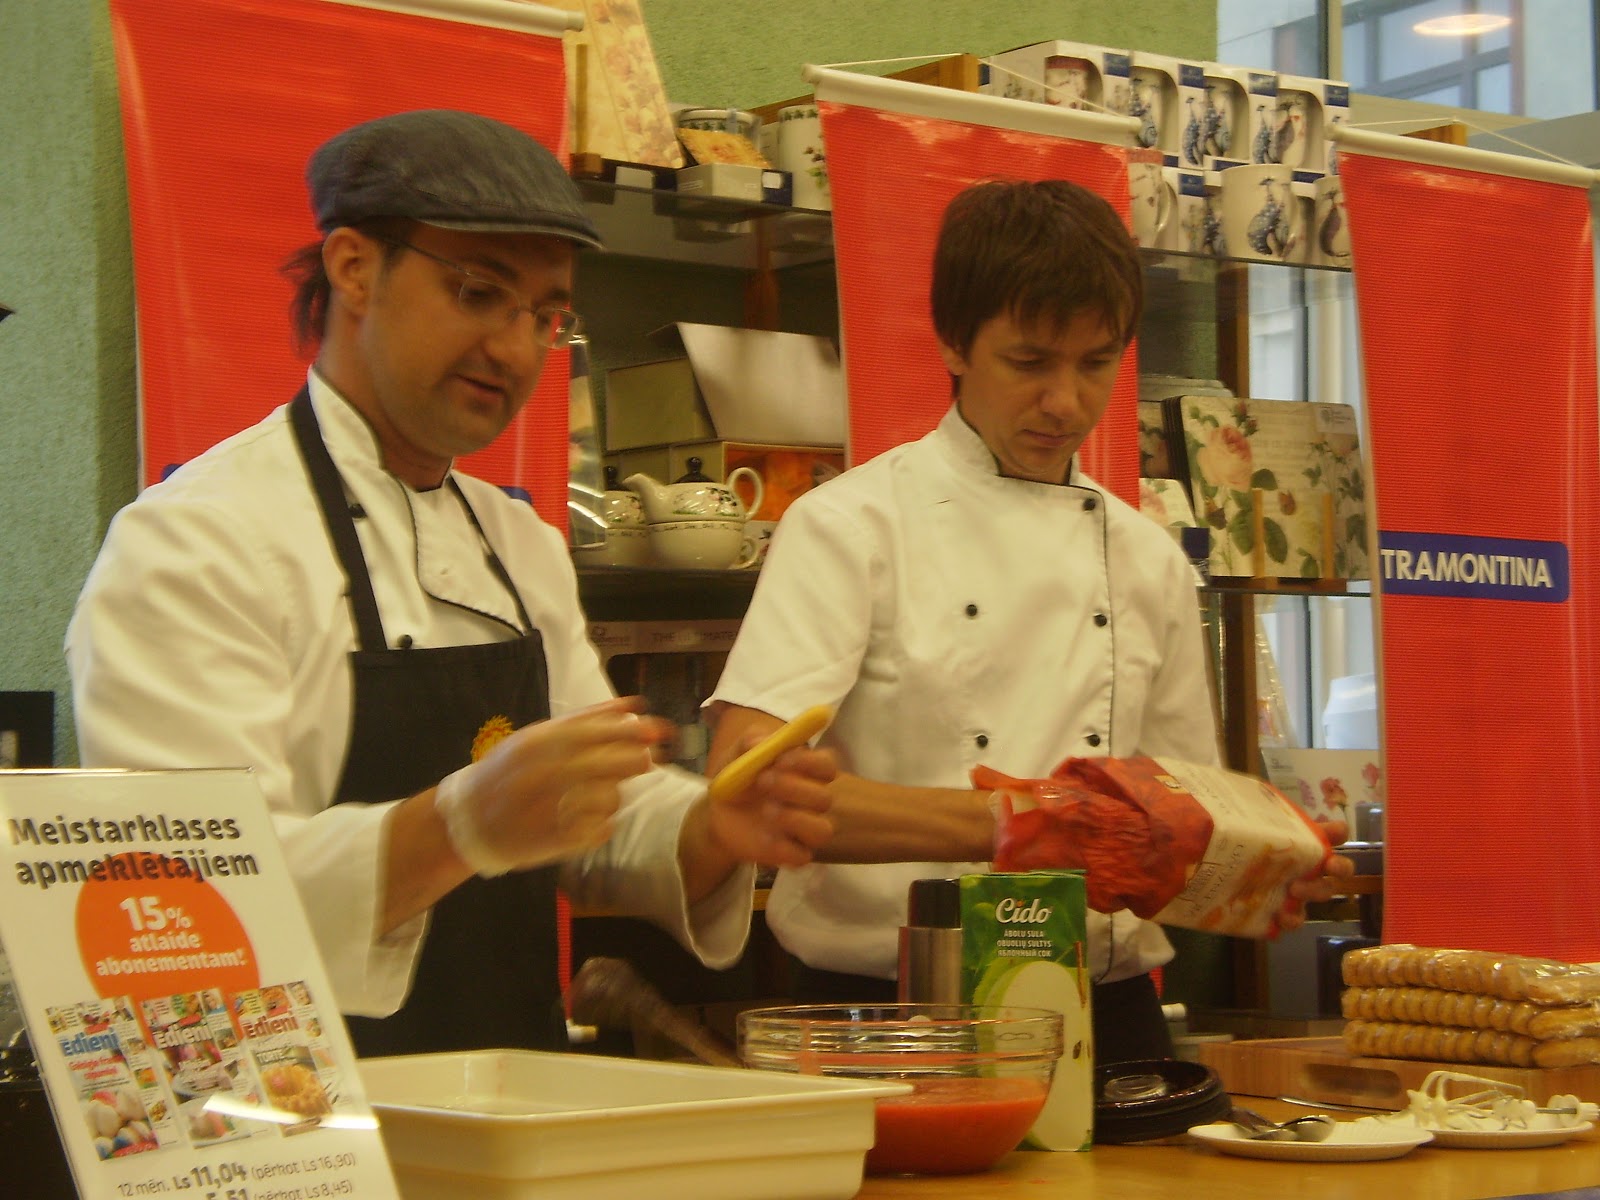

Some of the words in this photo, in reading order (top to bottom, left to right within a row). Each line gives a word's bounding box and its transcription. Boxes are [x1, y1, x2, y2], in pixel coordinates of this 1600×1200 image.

[1380, 548, 1554, 588] TRAMONTINA
[8, 814, 241, 845] Meistarklases
[15, 849, 260, 889] apmeklētājiem
[119, 896, 192, 932] 15%
[995, 897, 1053, 924] Cido
[129, 931, 201, 953] atlaide
[1027, 940, 1052, 948] SULTYS
[117, 1182, 133, 1197] 12
[135, 1178, 170, 1196] mēn.
[190, 1161, 247, 1189] 11,04
